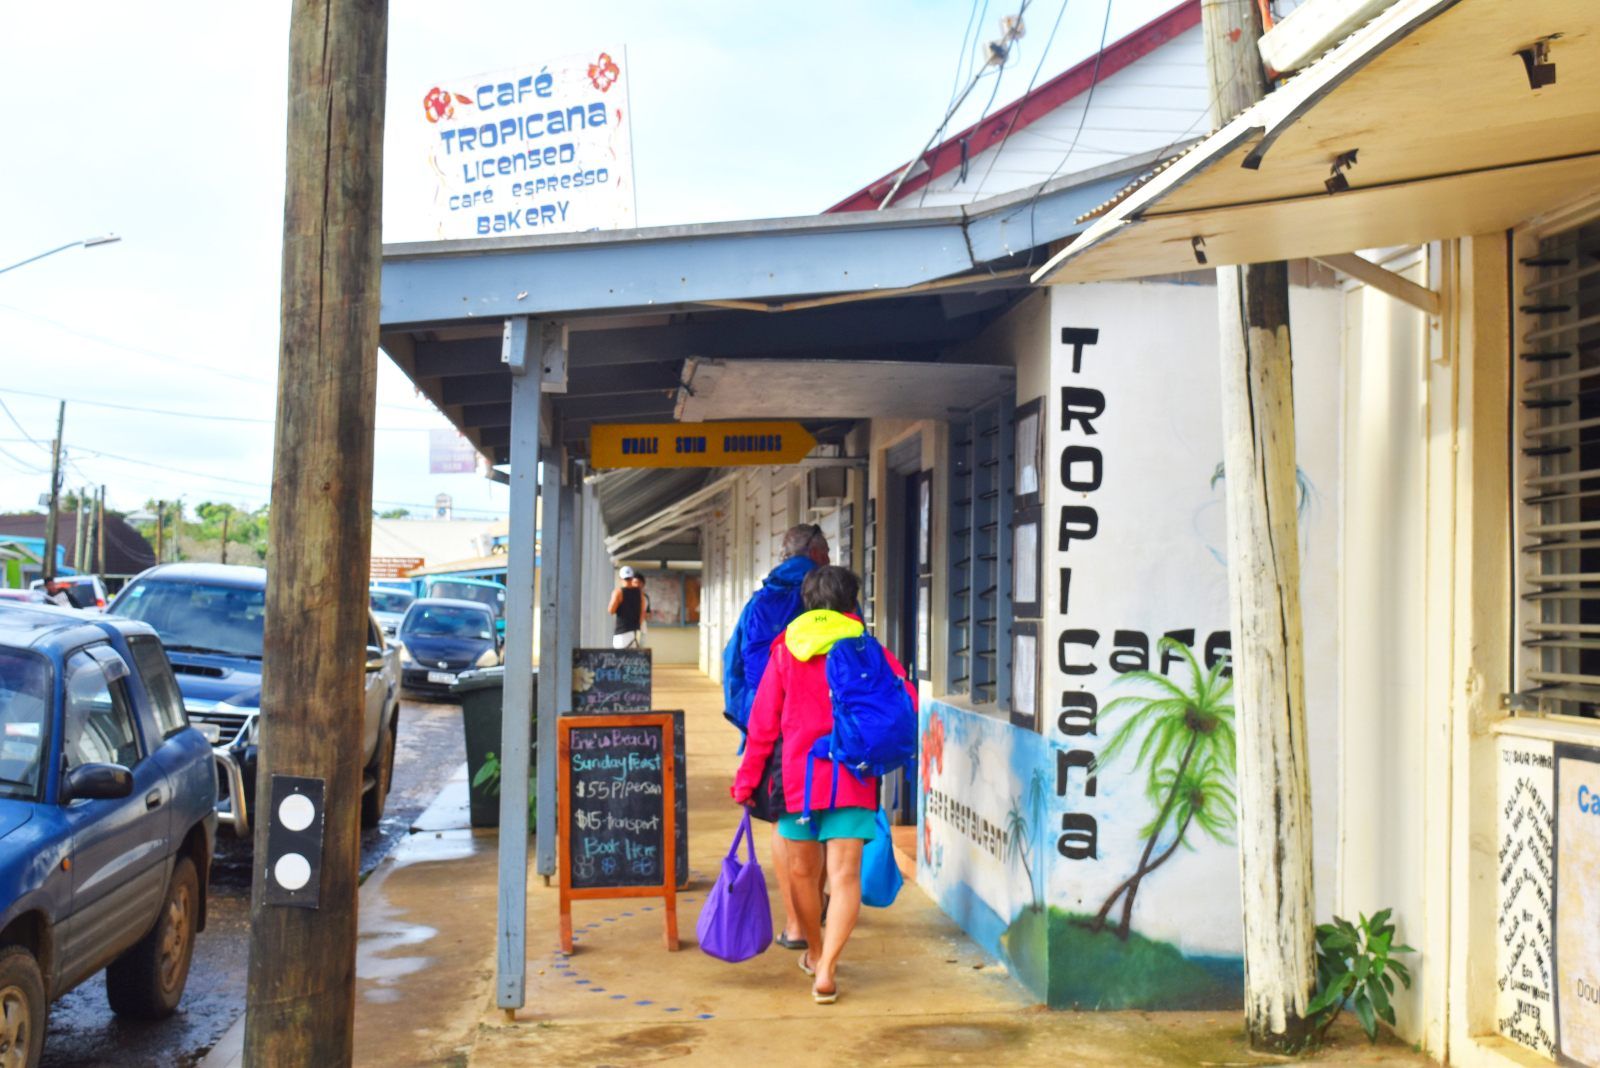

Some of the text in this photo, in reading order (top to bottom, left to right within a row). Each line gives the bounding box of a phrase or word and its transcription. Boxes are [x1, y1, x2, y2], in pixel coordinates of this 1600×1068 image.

[612, 729, 657, 750] Beach
[572, 752, 661, 781] Sunday Feast
[584, 837, 619, 858] Book
